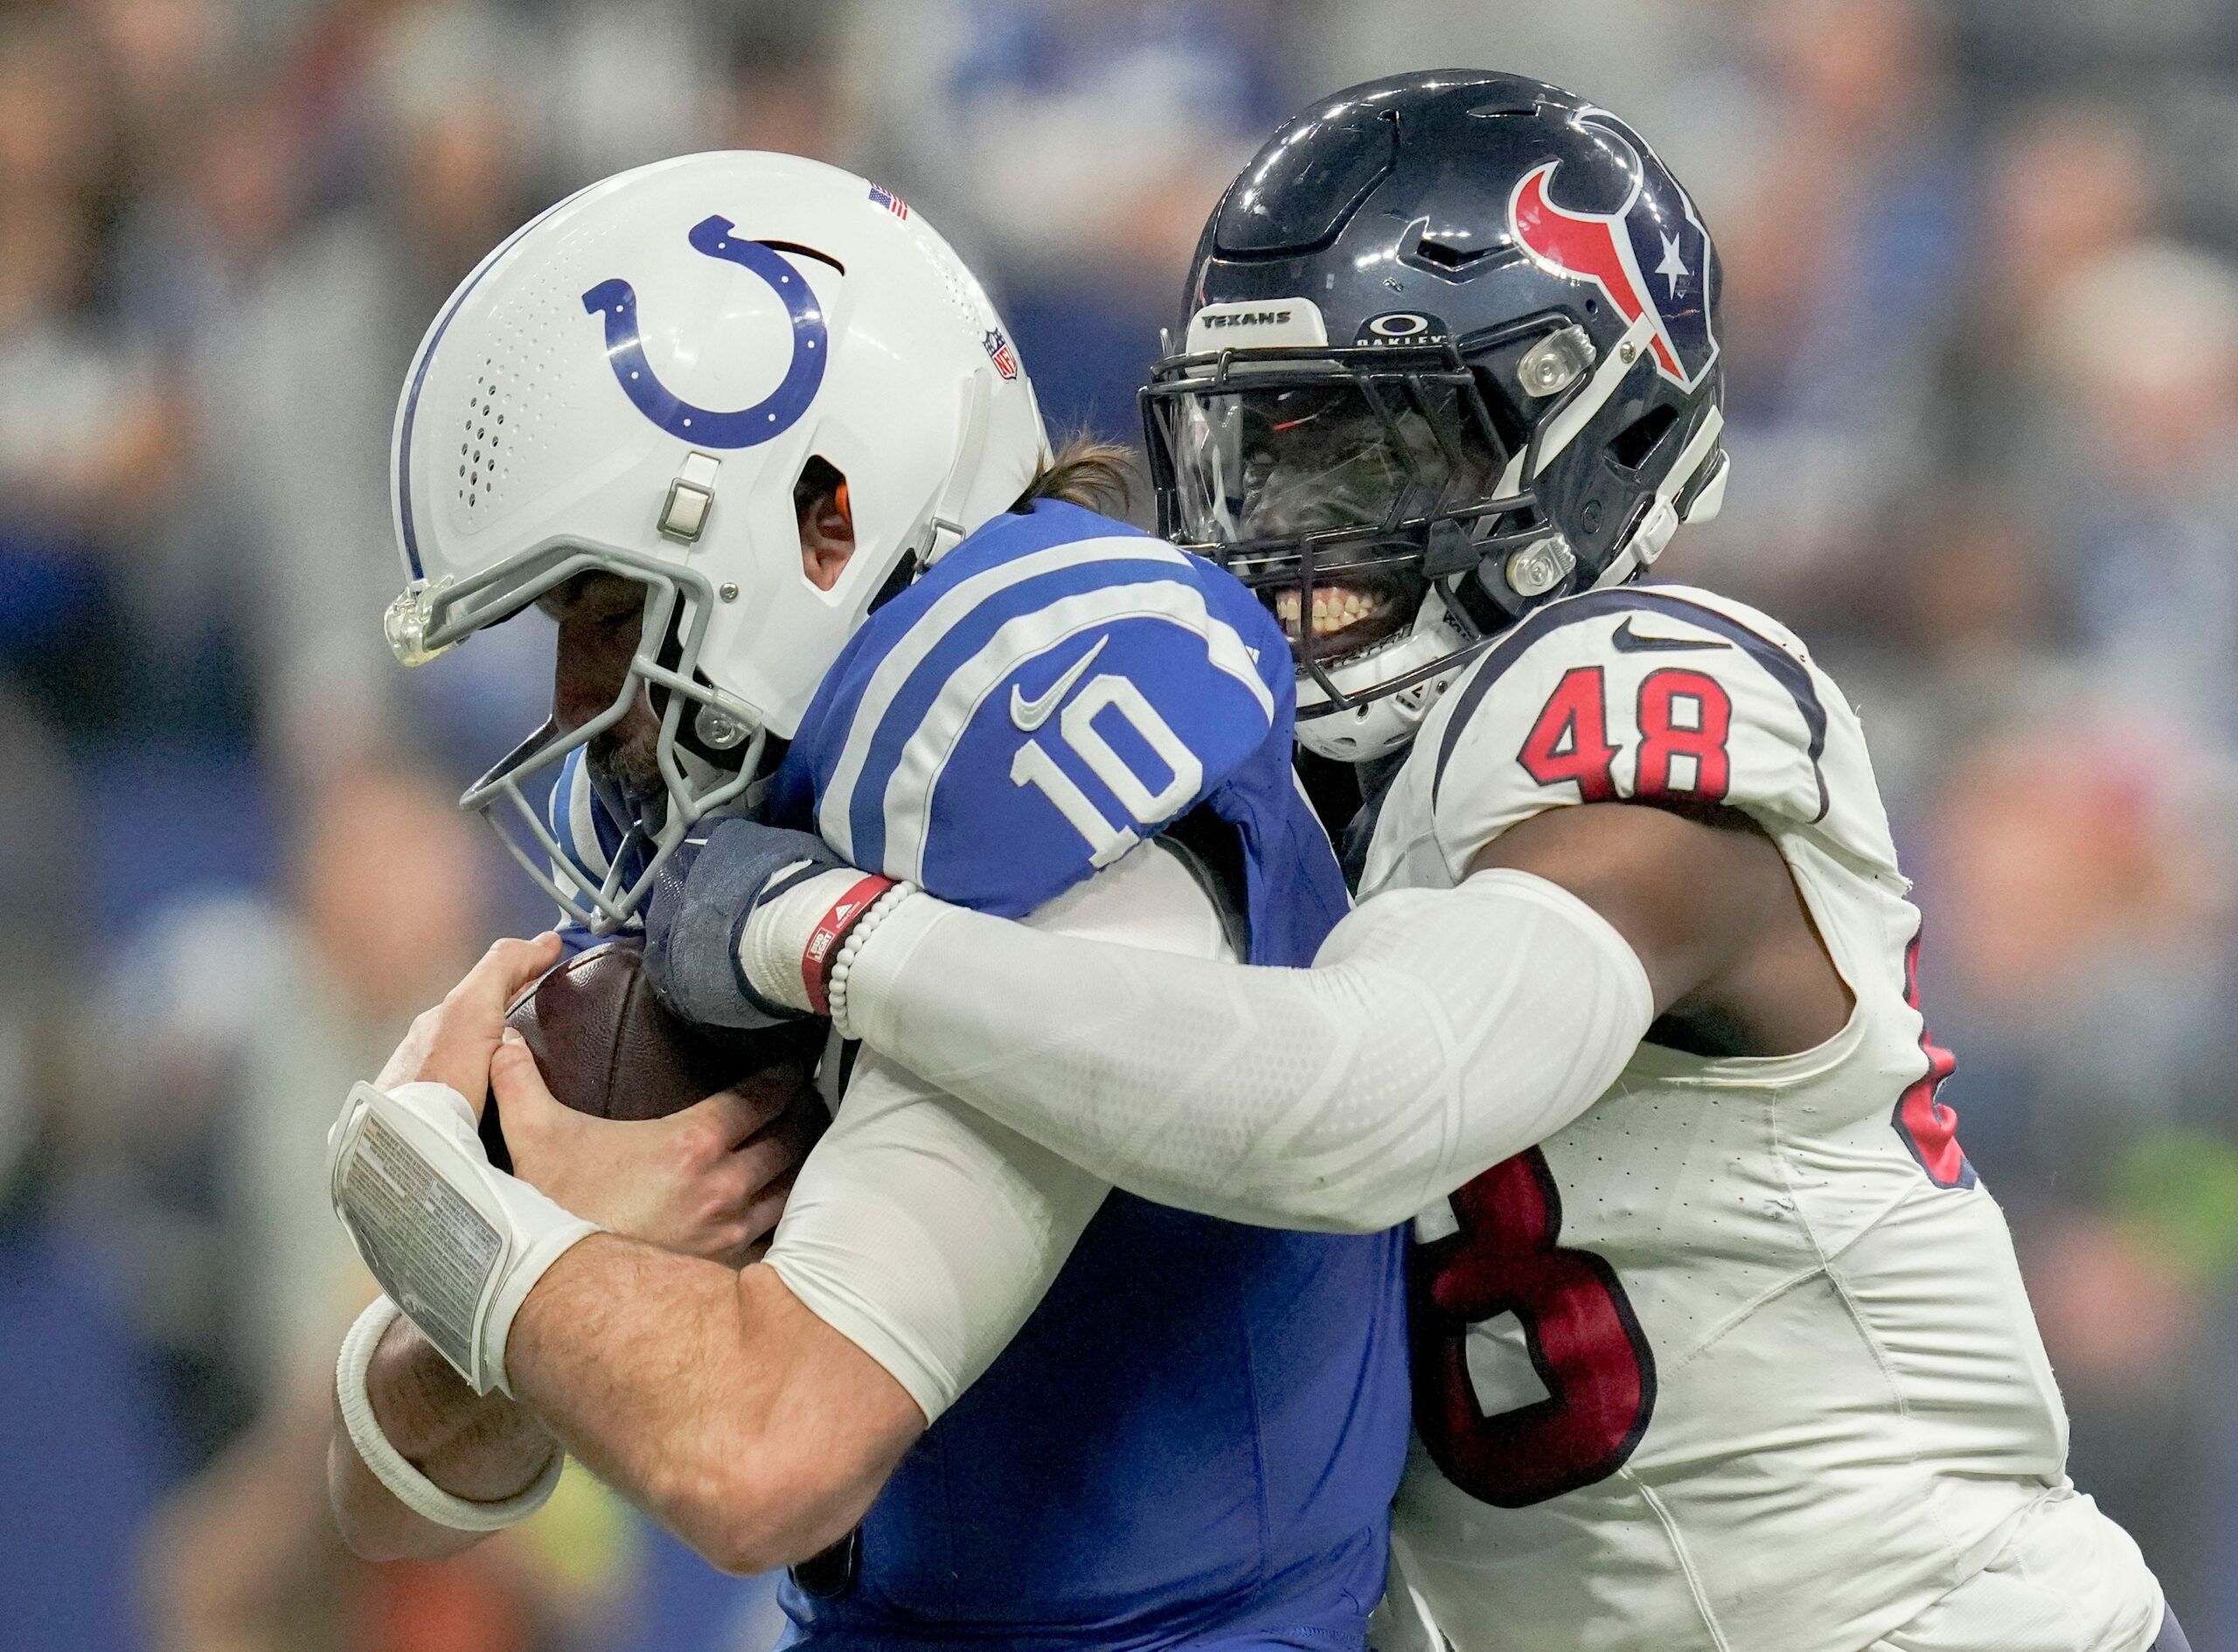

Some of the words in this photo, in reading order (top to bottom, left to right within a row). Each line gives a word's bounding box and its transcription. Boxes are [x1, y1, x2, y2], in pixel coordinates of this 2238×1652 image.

[1202, 311, 1292, 329] TEXANS
[993, 346, 1016, 376] NFL
[1517, 665, 1732, 805] 48
[1010, 674, 1203, 869] 10
[810, 934, 824, 954] BUD
[814, 933, 832, 961] LIGHT
